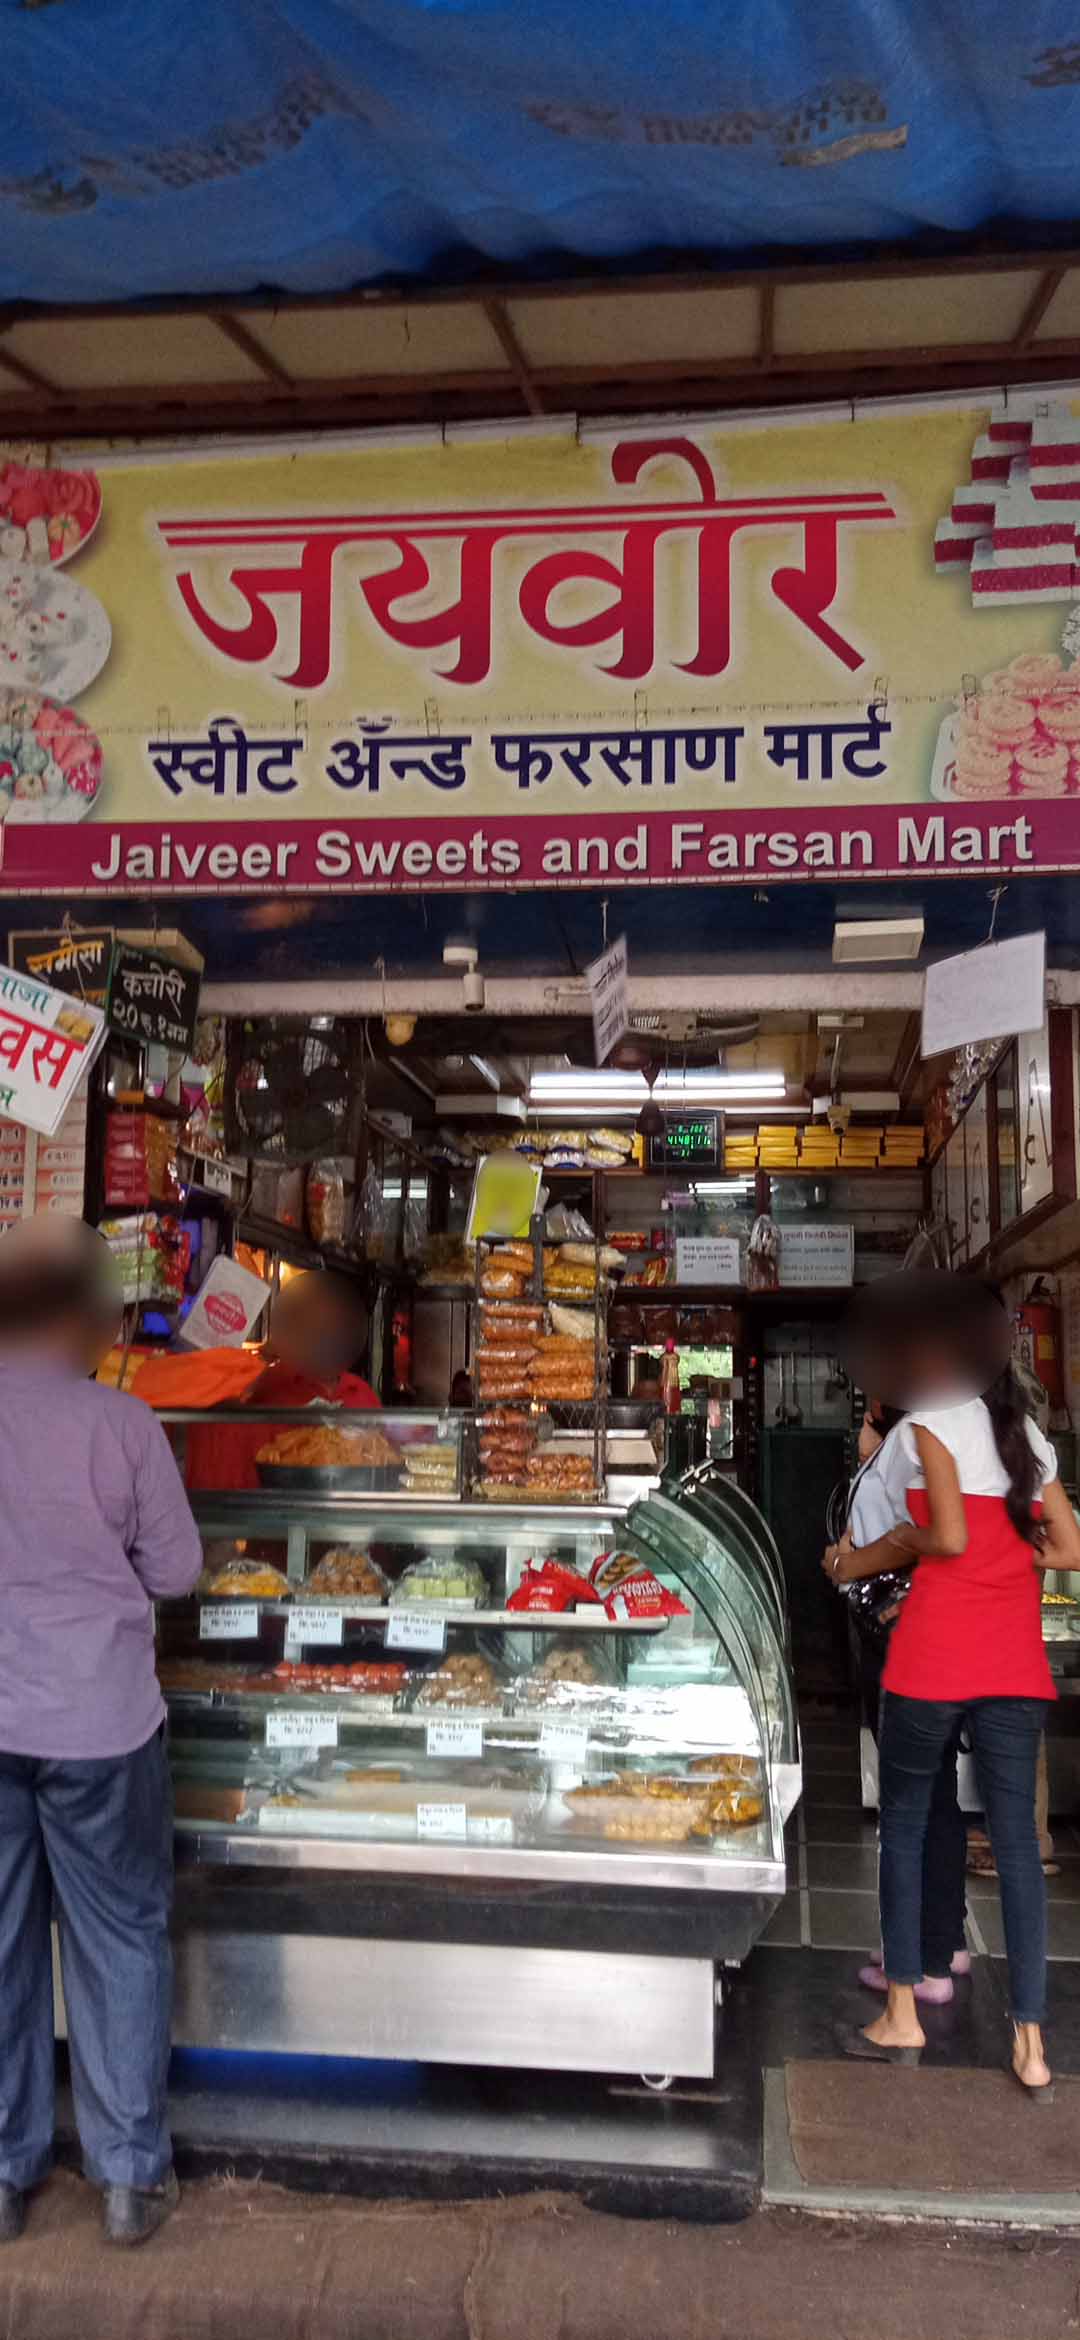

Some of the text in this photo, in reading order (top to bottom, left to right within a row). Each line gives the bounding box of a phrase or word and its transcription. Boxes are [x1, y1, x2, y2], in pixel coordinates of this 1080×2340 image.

[158, 437, 896, 689] जयवीर
[148, 717, 303, 795] स्वीट
[490, 726, 744, 788] फरसाण
[763, 704, 891, 780] मार्ट
[91, 814, 1032, 880] Jaiveer Sweets and Farsan Mart
